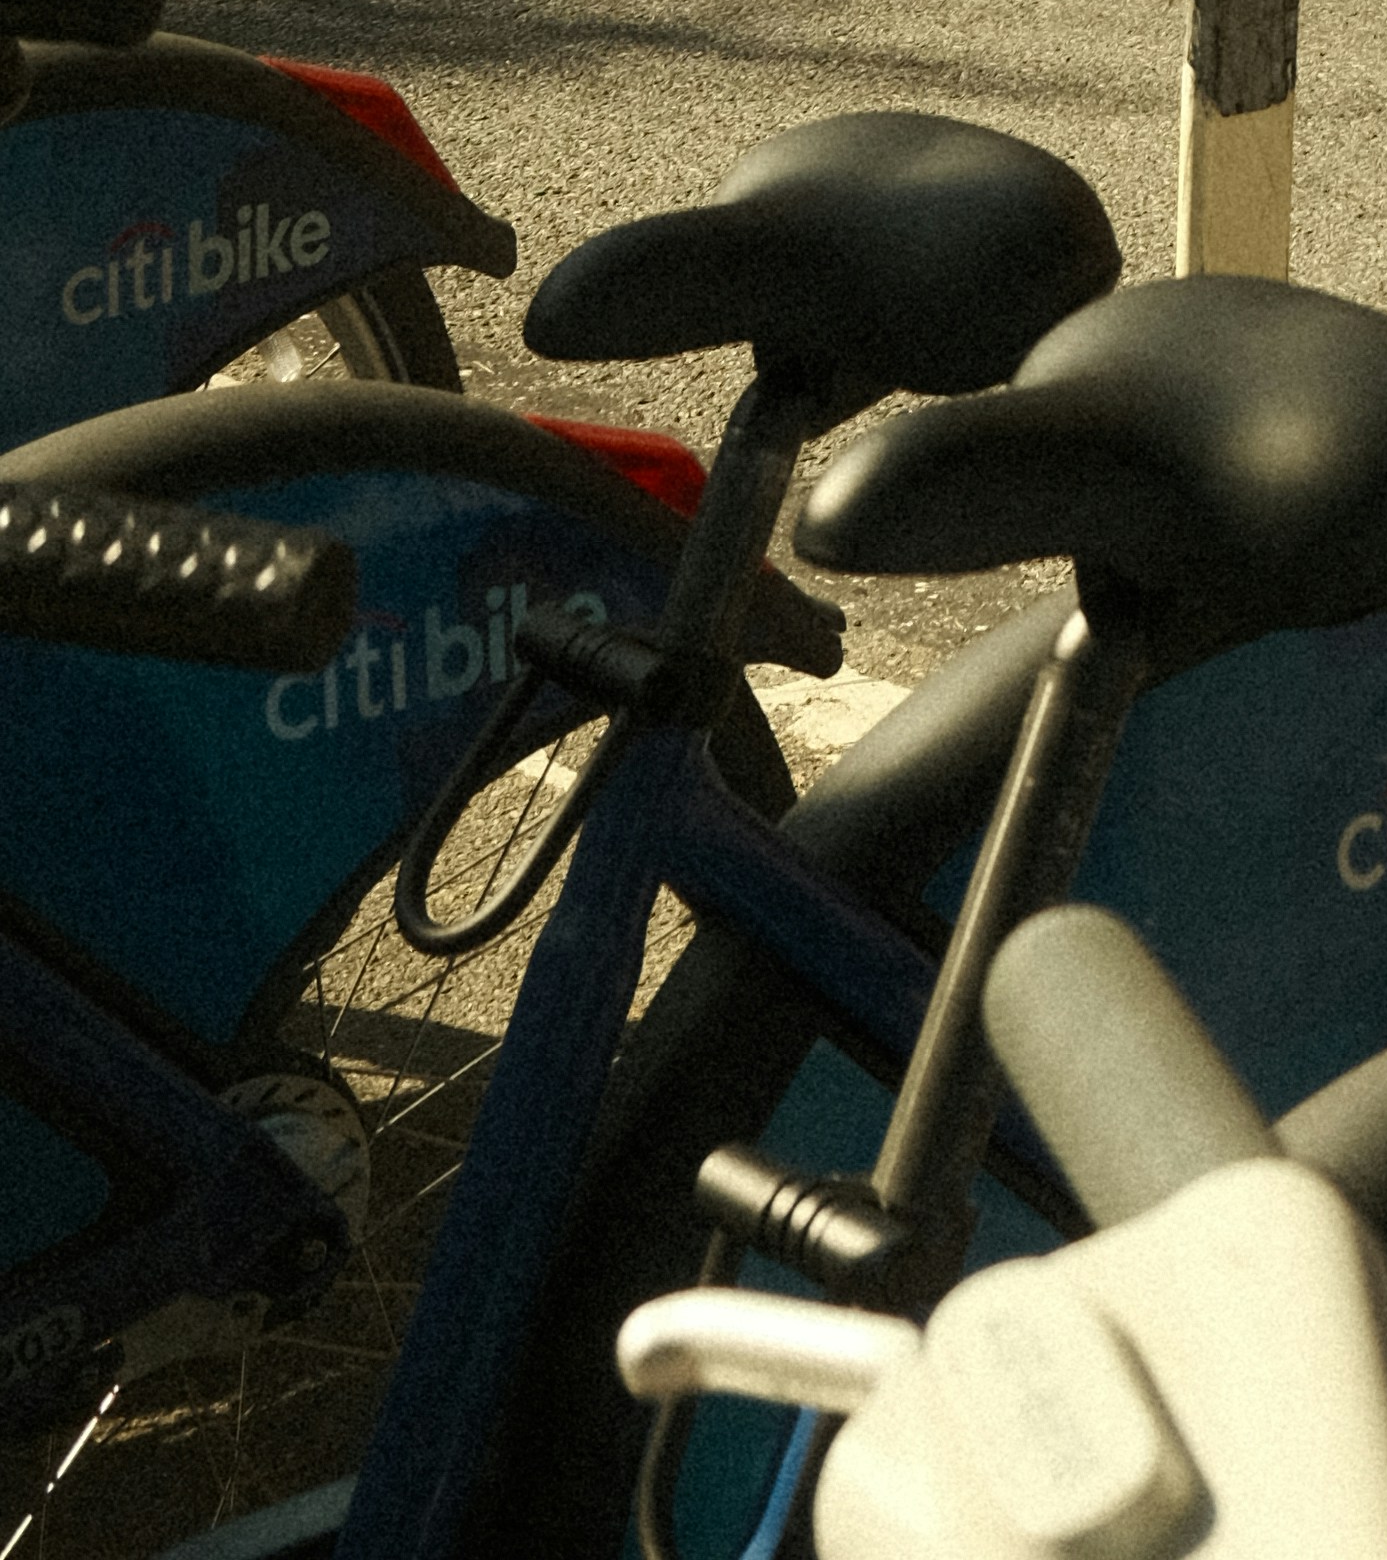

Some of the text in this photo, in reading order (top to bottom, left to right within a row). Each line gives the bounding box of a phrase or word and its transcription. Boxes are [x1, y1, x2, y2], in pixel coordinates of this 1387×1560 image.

[61, 203, 331, 326] citi bike
[266, 628, 407, 741] citi
